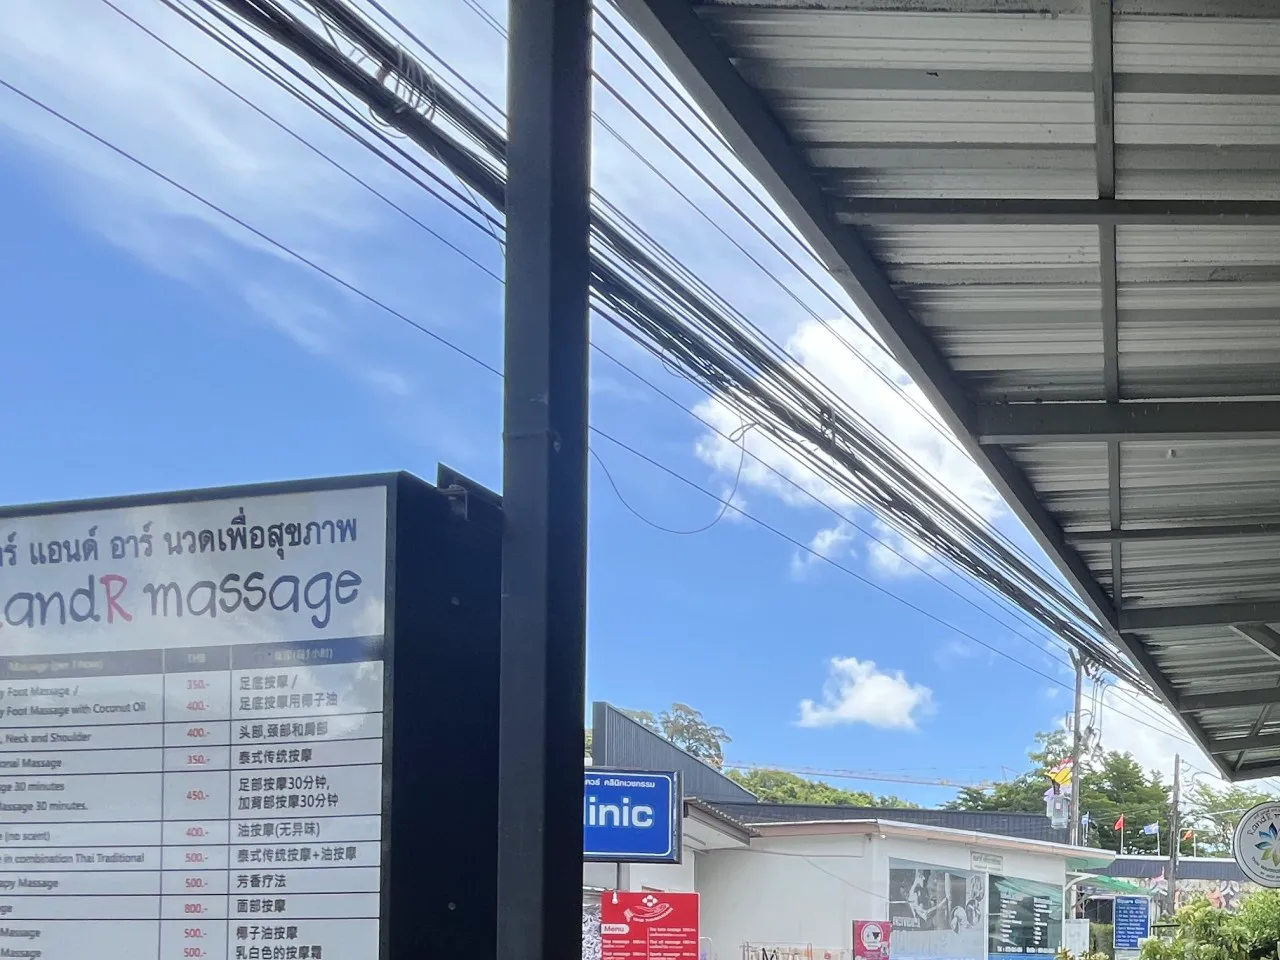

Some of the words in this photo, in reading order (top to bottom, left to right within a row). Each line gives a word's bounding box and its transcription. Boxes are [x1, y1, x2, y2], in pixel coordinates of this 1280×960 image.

[29, 525, 99, 565] แอนด์
[110, 520, 153, 559] อาร์
[163, 506, 357, 560] นวดเพื่อสุขภาพ
[0, 573, 132, 628] andR
[143, 569, 362, 629] massage
[30, 705, 69, 717] Massage
[92, 702, 131, 713] Coconut
[132, 701, 146, 712] Oil
[5, 733, 29, 743] Neck
[31, 733, 48, 743] and
[50, 732, 92, 742] Shoulder
[22, 758, 62, 770] Massage
[27, 782, 65, 791] minutes
[584, 796, 653, 827] inic
[18, 879, 59, 890] Massage
[237, 874, 287, 889] 芳香疗法
[237, 899, 286, 914] 面部按摩
